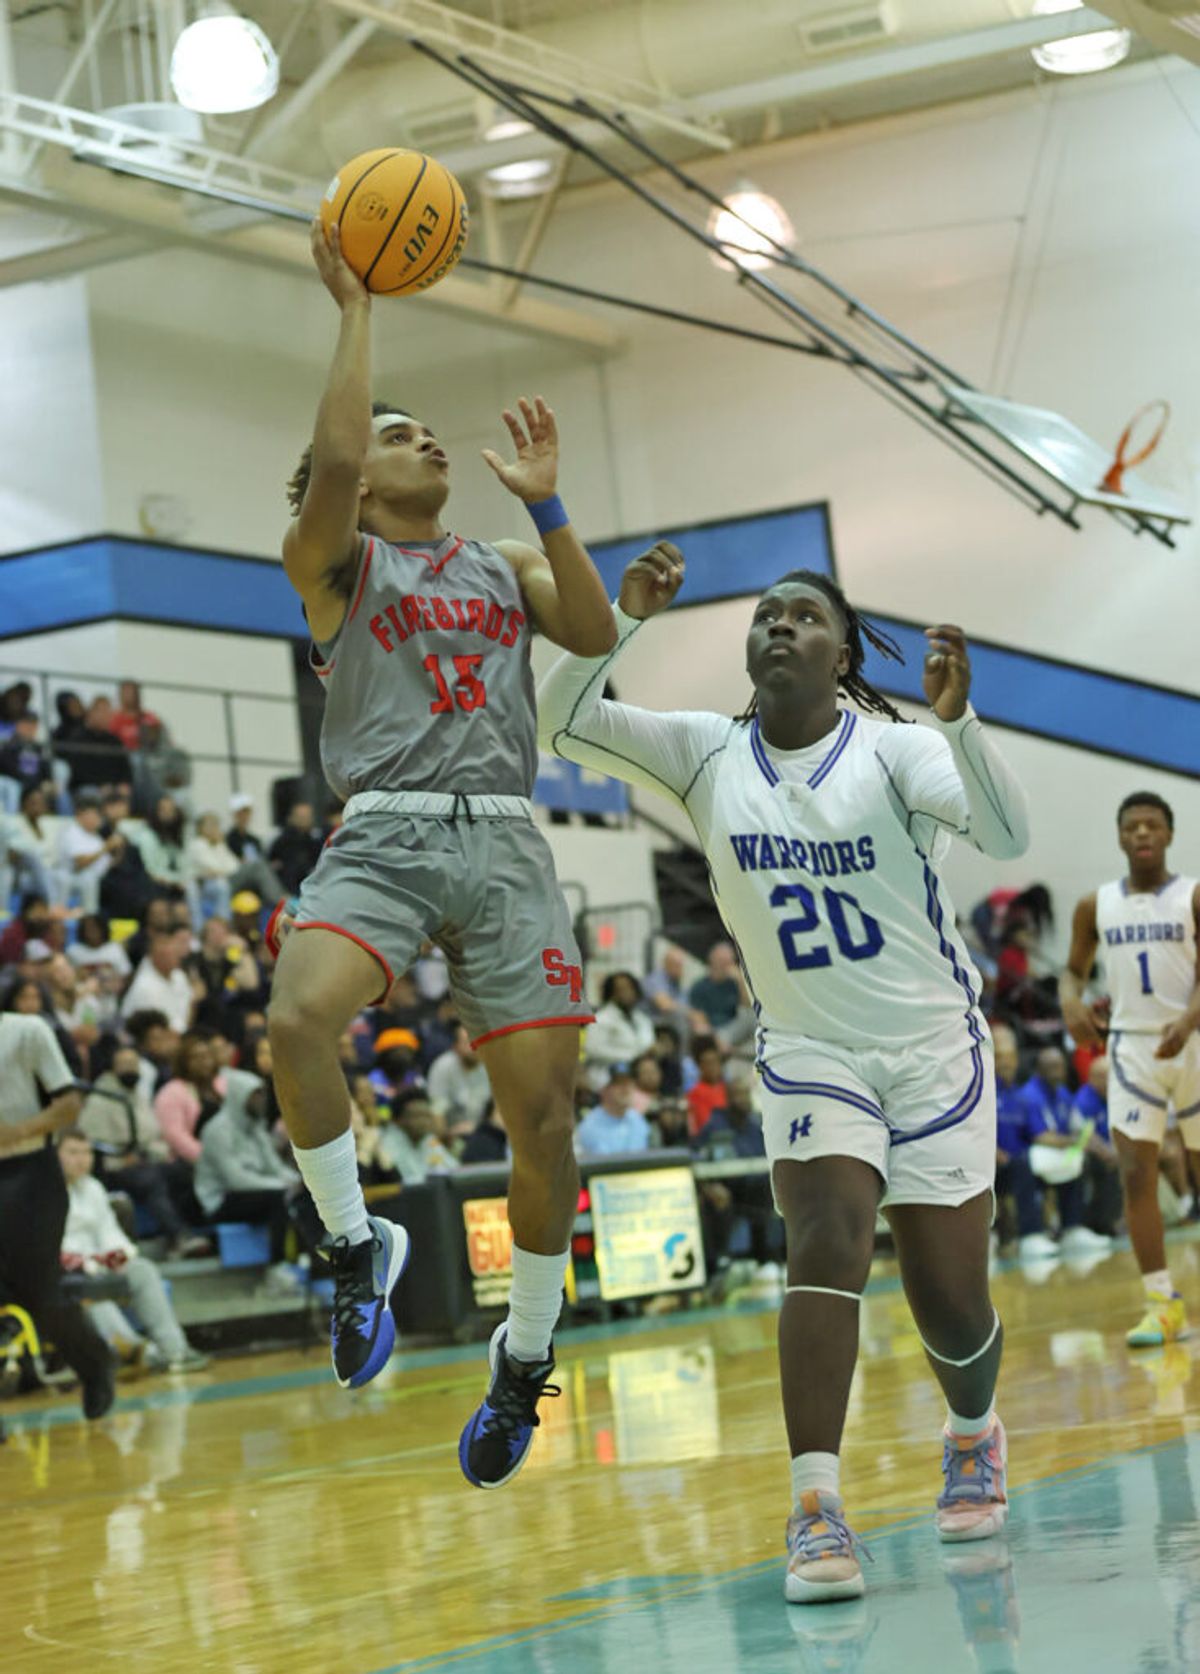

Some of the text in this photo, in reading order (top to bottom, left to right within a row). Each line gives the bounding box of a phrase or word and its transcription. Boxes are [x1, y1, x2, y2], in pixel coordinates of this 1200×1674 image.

[403, 204, 439, 263] EVO
[369, 593, 525, 653] FIREBIRDS
[423, 654, 487, 715] 15
[730, 833, 876, 877] WARRIORS
[769, 883, 885, 972] 20
[1137, 951, 1152, 994] 1
